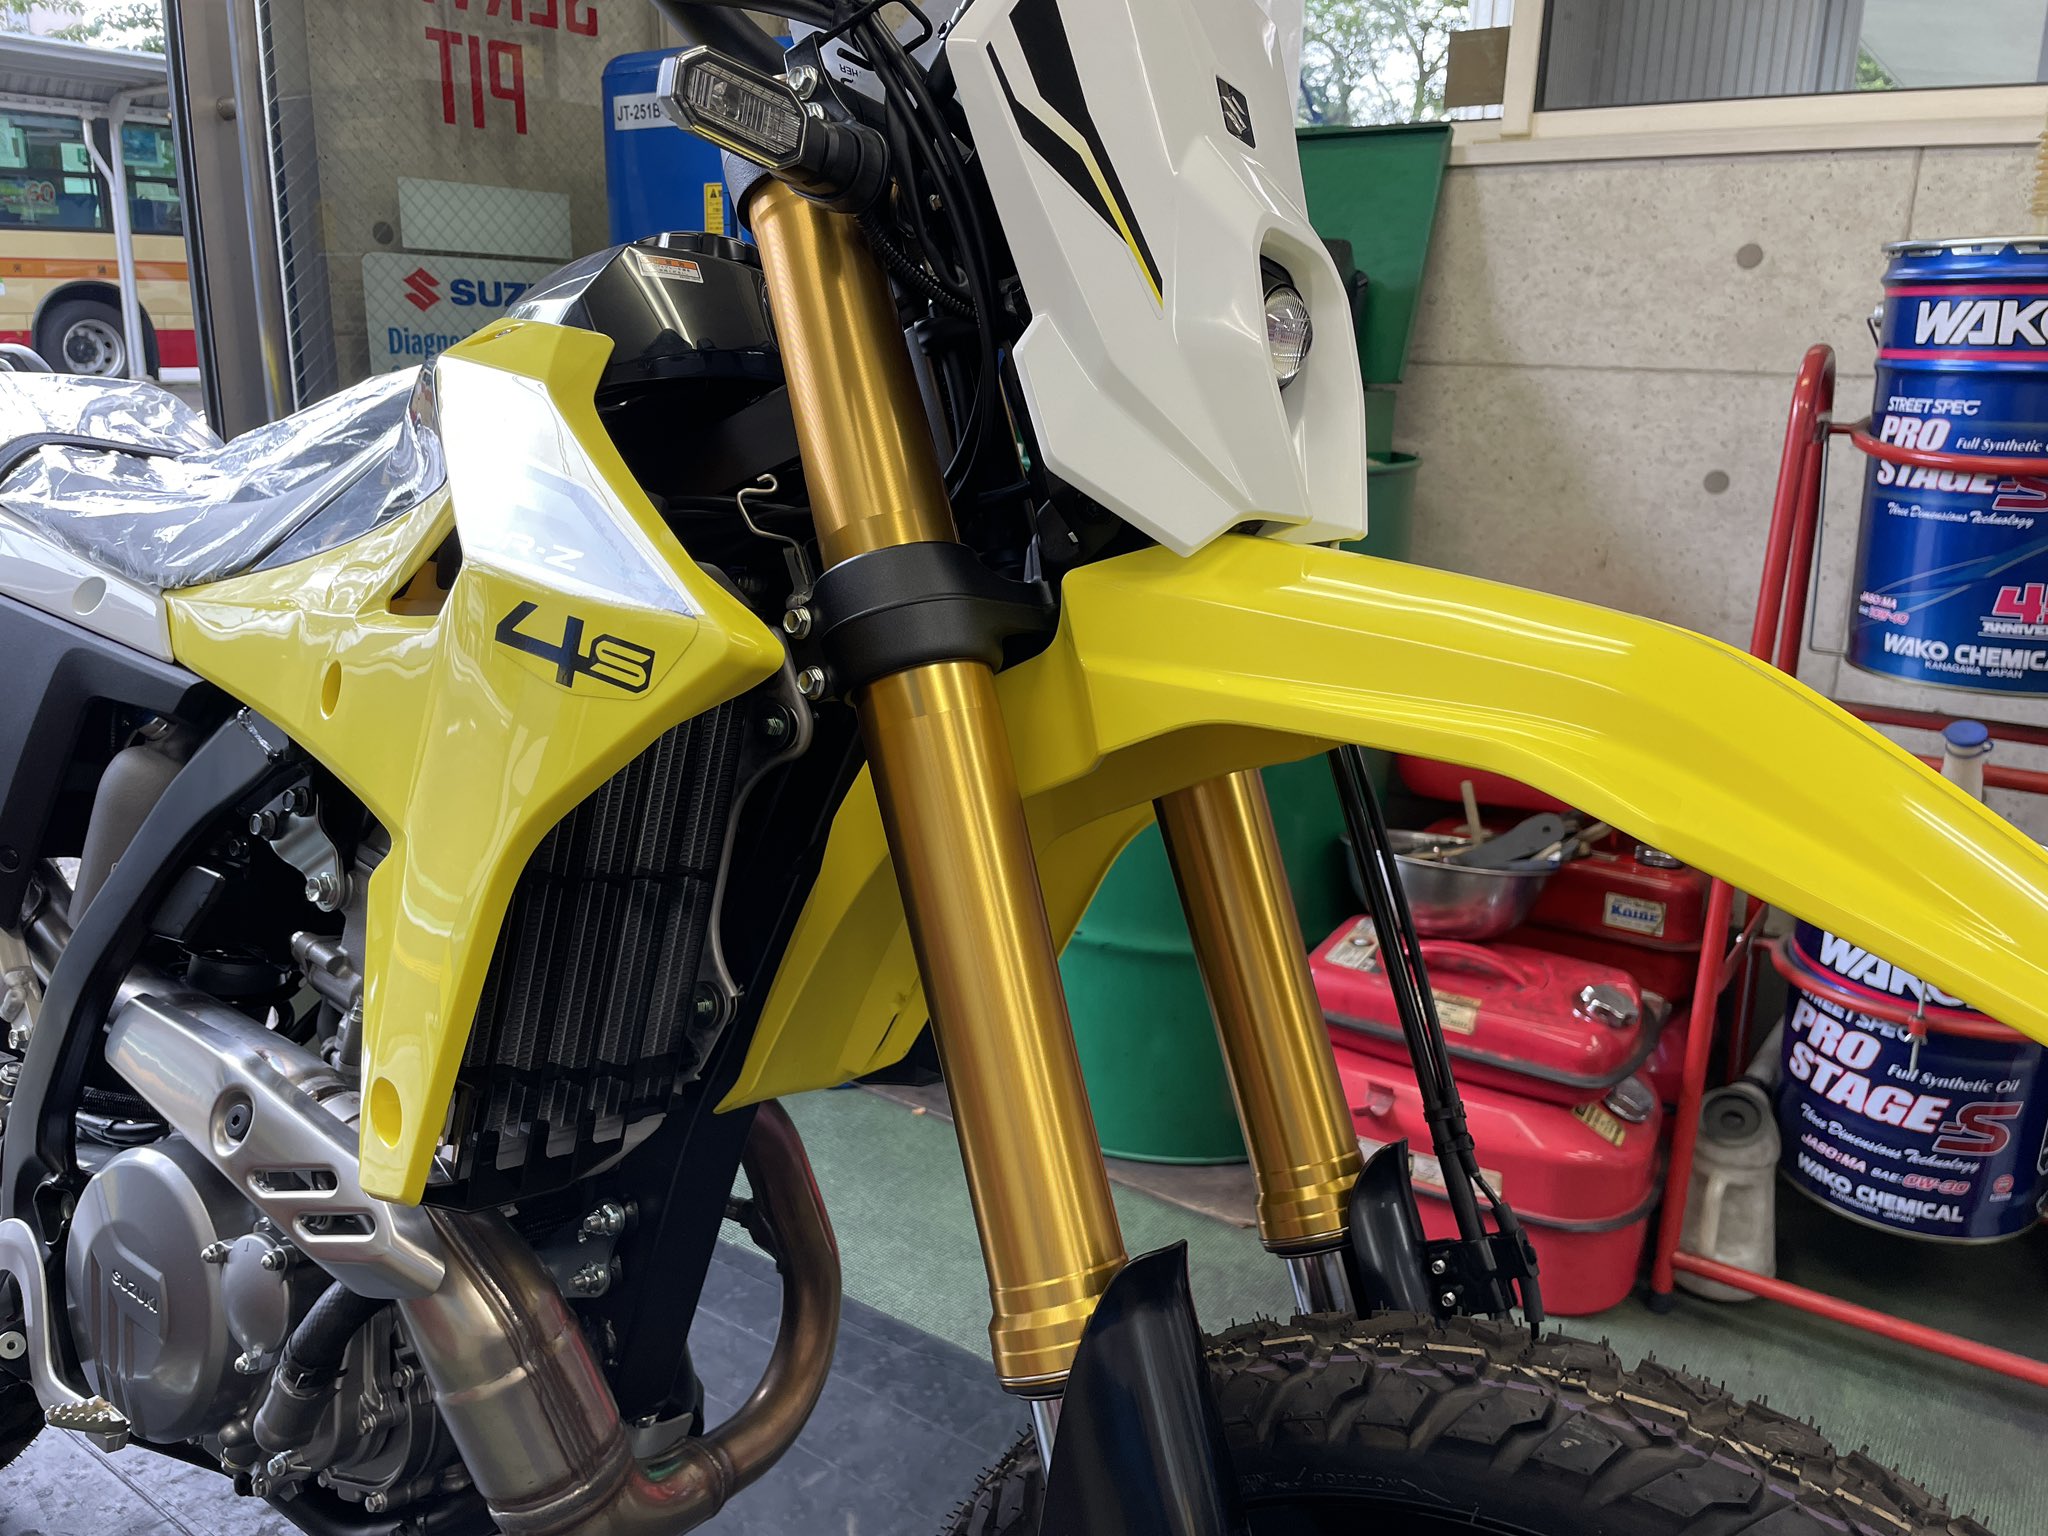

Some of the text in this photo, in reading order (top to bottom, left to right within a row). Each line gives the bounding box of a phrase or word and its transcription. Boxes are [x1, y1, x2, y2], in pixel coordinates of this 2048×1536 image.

[617, 103, 661, 122] JT-251B
[450, 277, 537, 308] SUZ
[1914, 300, 2048, 345] WAK
[388, 327, 472, 359] Diagno
[1887, 396, 1981, 415] STREET SPEC
[1880, 415, 1951, 451] PRO
[1956, 437, 2042, 454] Full Synthetic
[1969, 510, 2035, 530] Technology
[1992, 583, 2048, 624] 4
[1884, 632, 1949, 661] WAKO
[1925, 660, 2024, 680] KANAGAWA JAPAN
[1791, 998, 1882, 1070] PRO
[1789, 1041, 1950, 1134] STAGE
[1887, 1063, 2022, 1094] Full Synthetic Oil
[1903, 1148, 1980, 1175] Technology
[1797, 1151, 1964, 1223] WAKO CHEMICAL
[111, 1269, 158, 1314] SUZUKI
